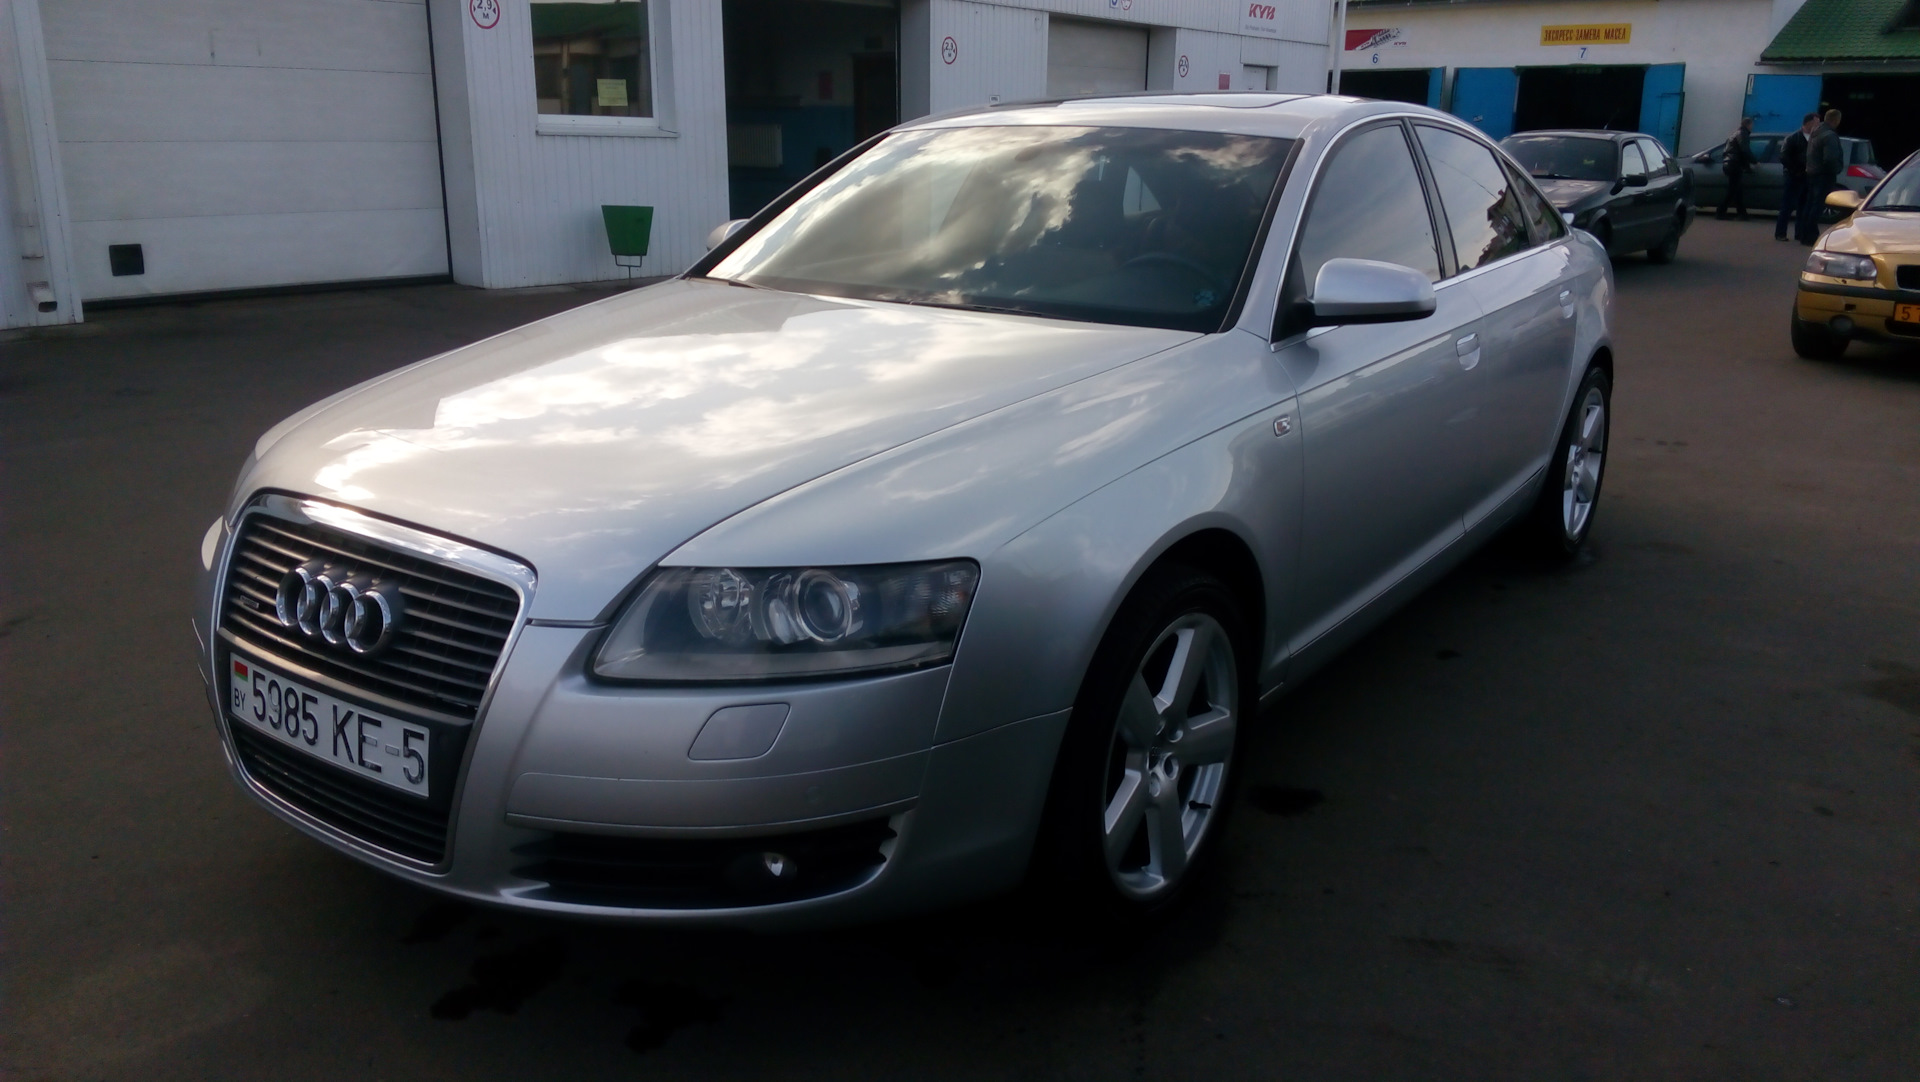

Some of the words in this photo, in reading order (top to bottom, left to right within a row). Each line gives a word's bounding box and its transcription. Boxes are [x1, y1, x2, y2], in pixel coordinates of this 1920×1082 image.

[1248, 3, 1276, 20] KYB
[1604, 28, 1626, 40] МАСЕЛ
[1372, 53, 1379, 64] 6
[1580, 48, 1587, 58] 7
[234, 687, 247, 711] BY
[252, 669, 319, 747] 5985
